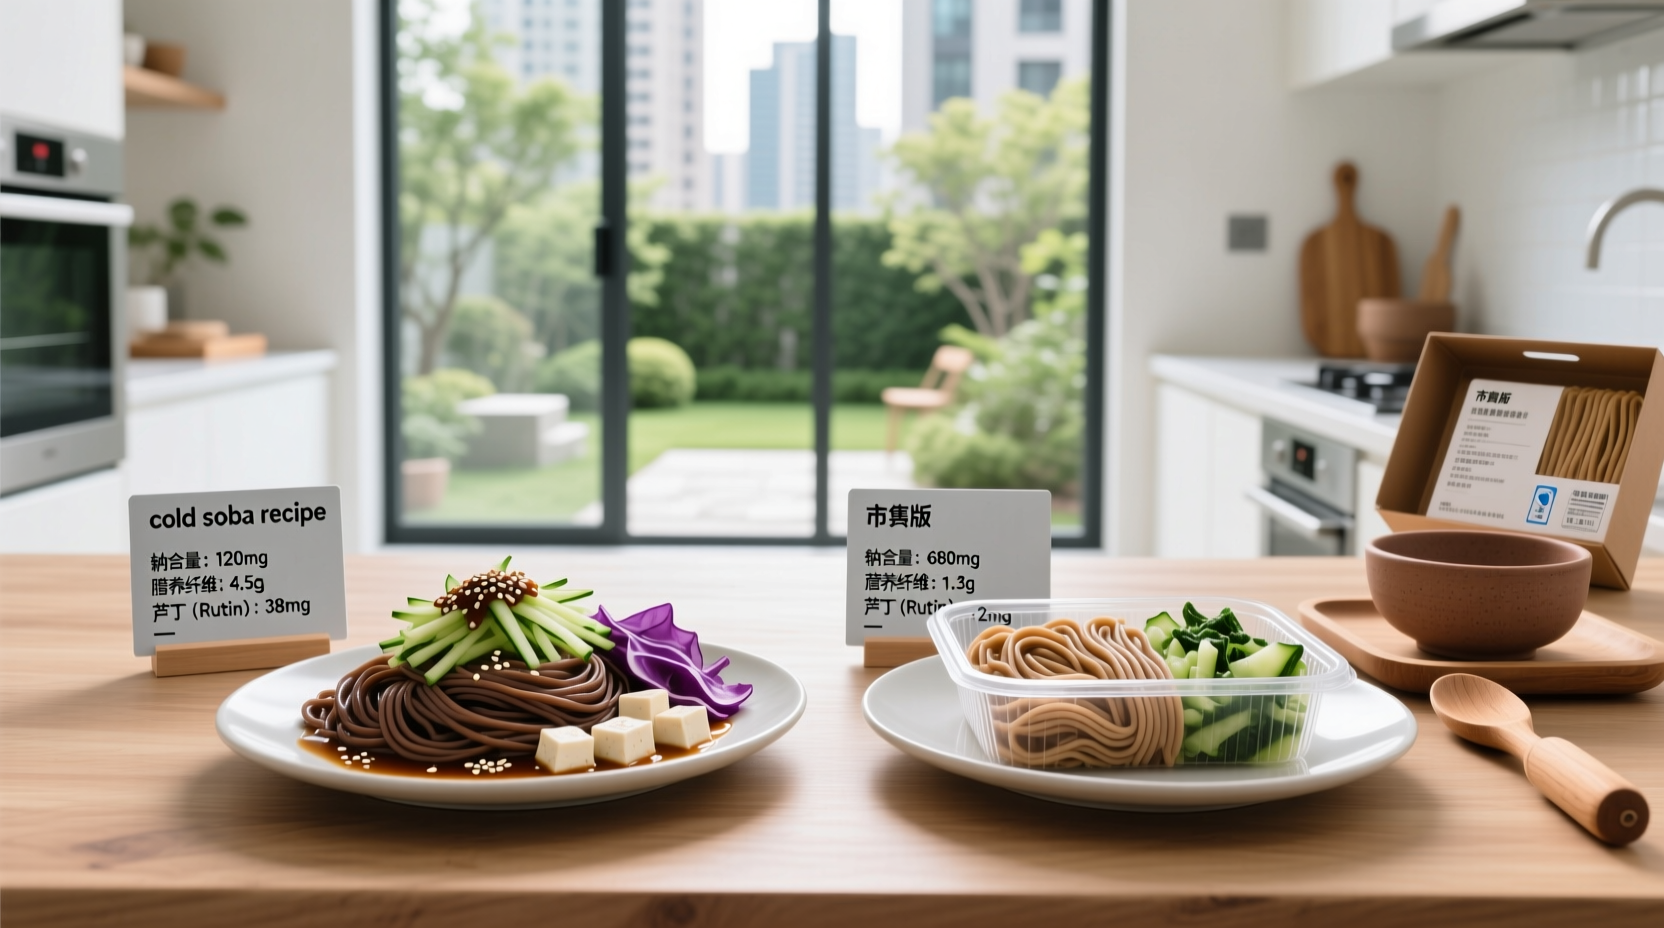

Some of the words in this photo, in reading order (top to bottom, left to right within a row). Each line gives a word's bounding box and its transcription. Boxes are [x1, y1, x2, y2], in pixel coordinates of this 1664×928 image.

[149, 506, 196, 529] cold
[202, 504, 255, 527] soba
[260, 501, 327, 527] recipe
[215, 550, 269, 569] 120mg
[926, 550, 981, 569] 680mg
[229, 574, 265, 594] 4.5g
[942, 575, 976, 594] 1.3g
[265, 597, 311, 616] 38mg
